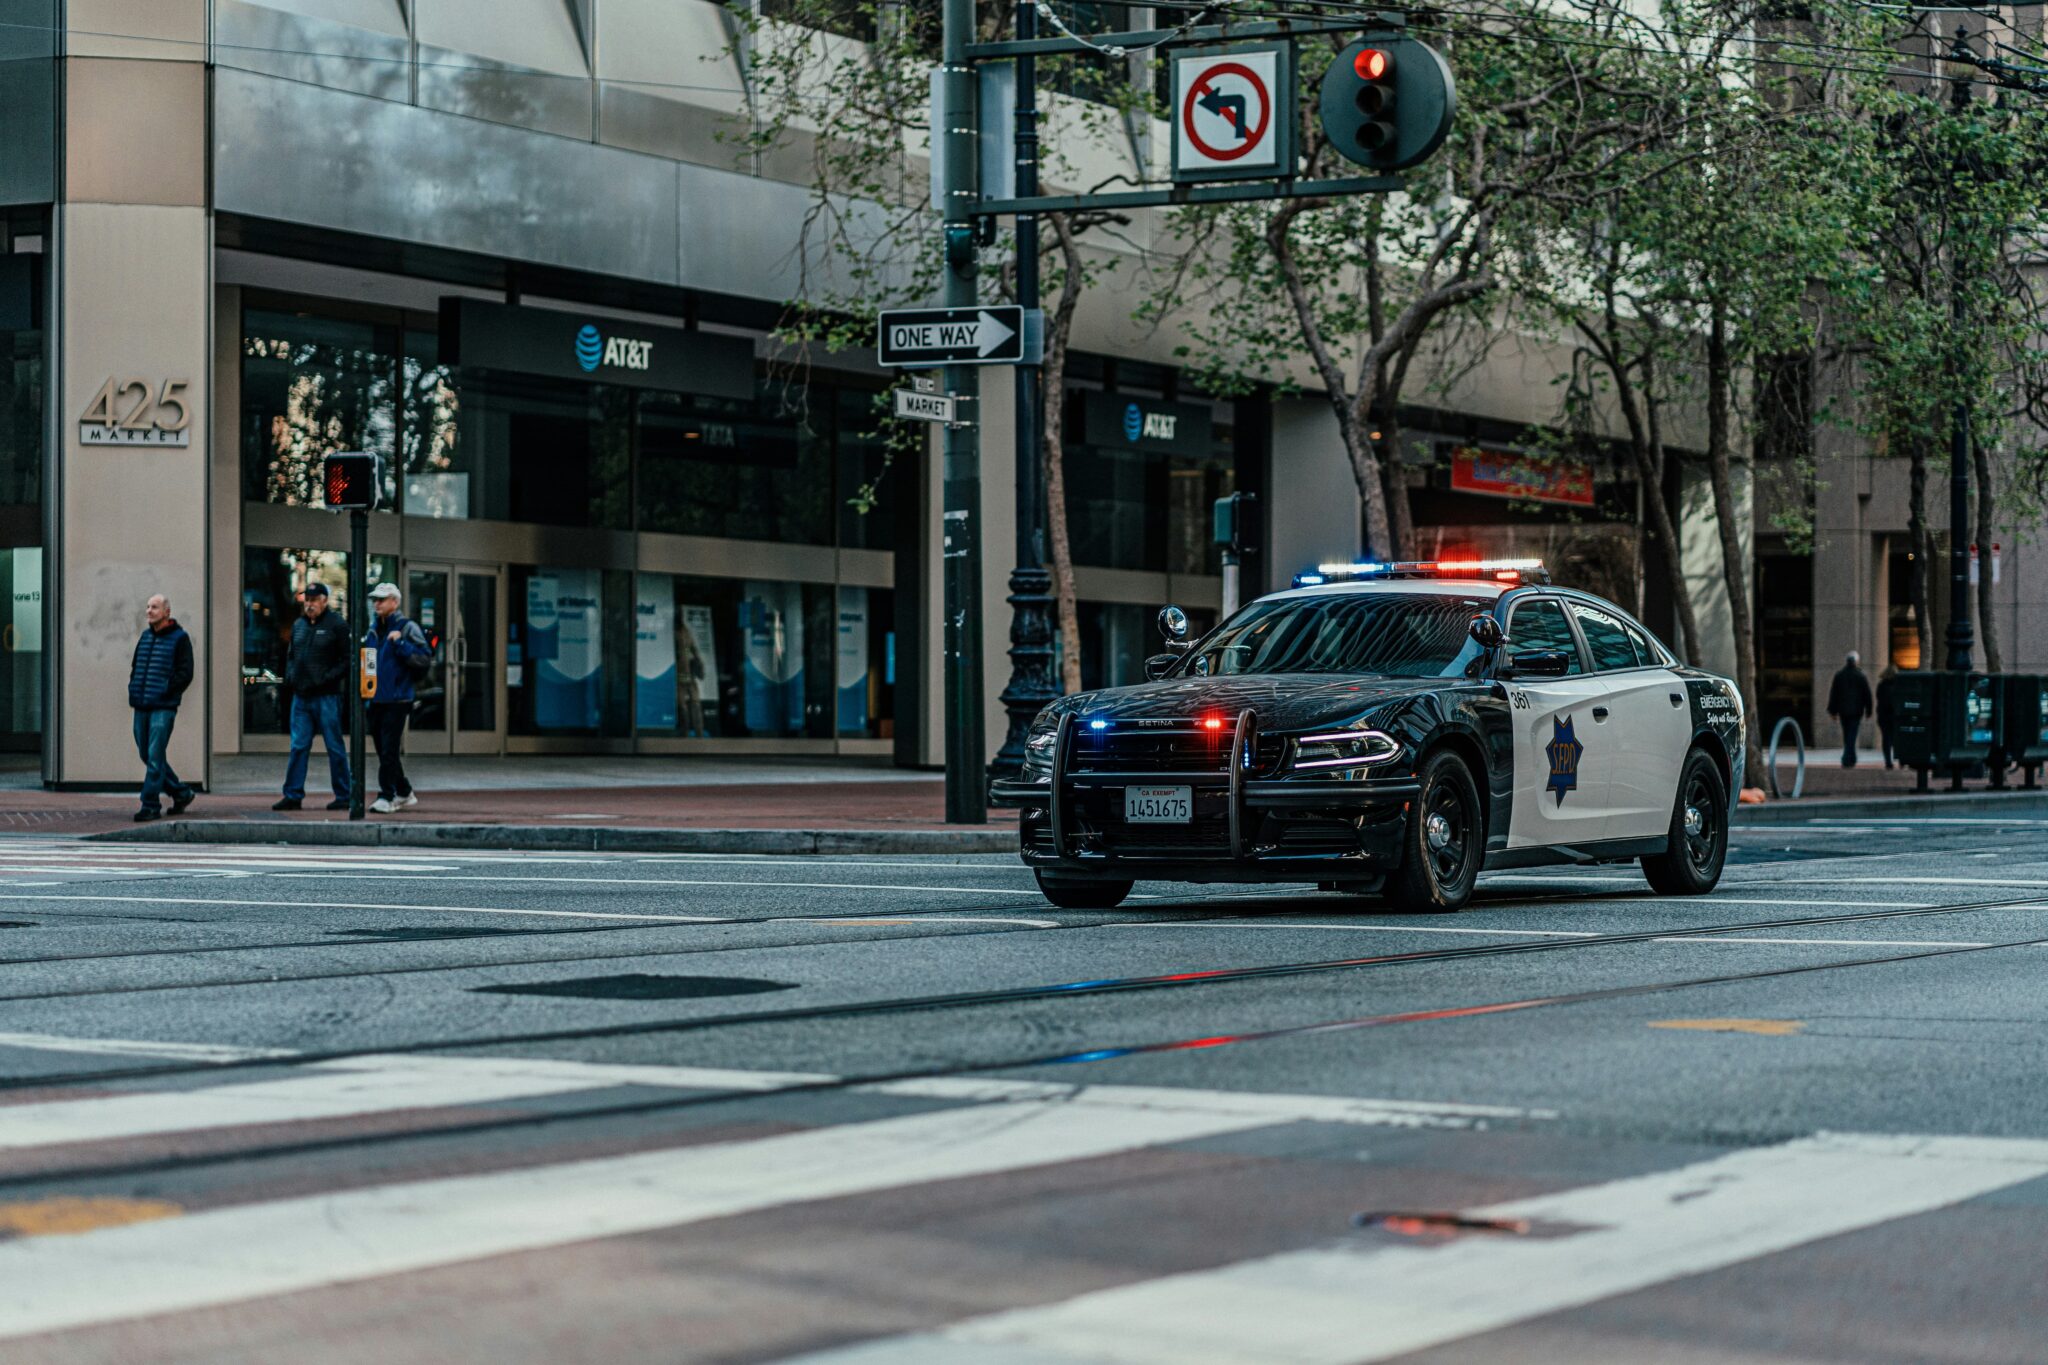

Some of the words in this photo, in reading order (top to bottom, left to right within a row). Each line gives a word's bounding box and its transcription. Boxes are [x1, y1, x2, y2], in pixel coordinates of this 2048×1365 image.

[894, 327, 932, 348] ONE
[939, 325, 979, 346] WAY
[603, 336, 654, 371] AT&T
[79, 375, 190, 431] 425
[906, 396, 946, 417] MARKET
[90, 428, 181, 441] MARKET
[1142, 412, 1178, 440] AT&T
[1510, 692, 1531, 710] 361
[1700, 696, 1730, 709] EMERGENCY
[1138, 719, 1174, 727] SETINA
[1129, 799, 1187, 818] 1451675
